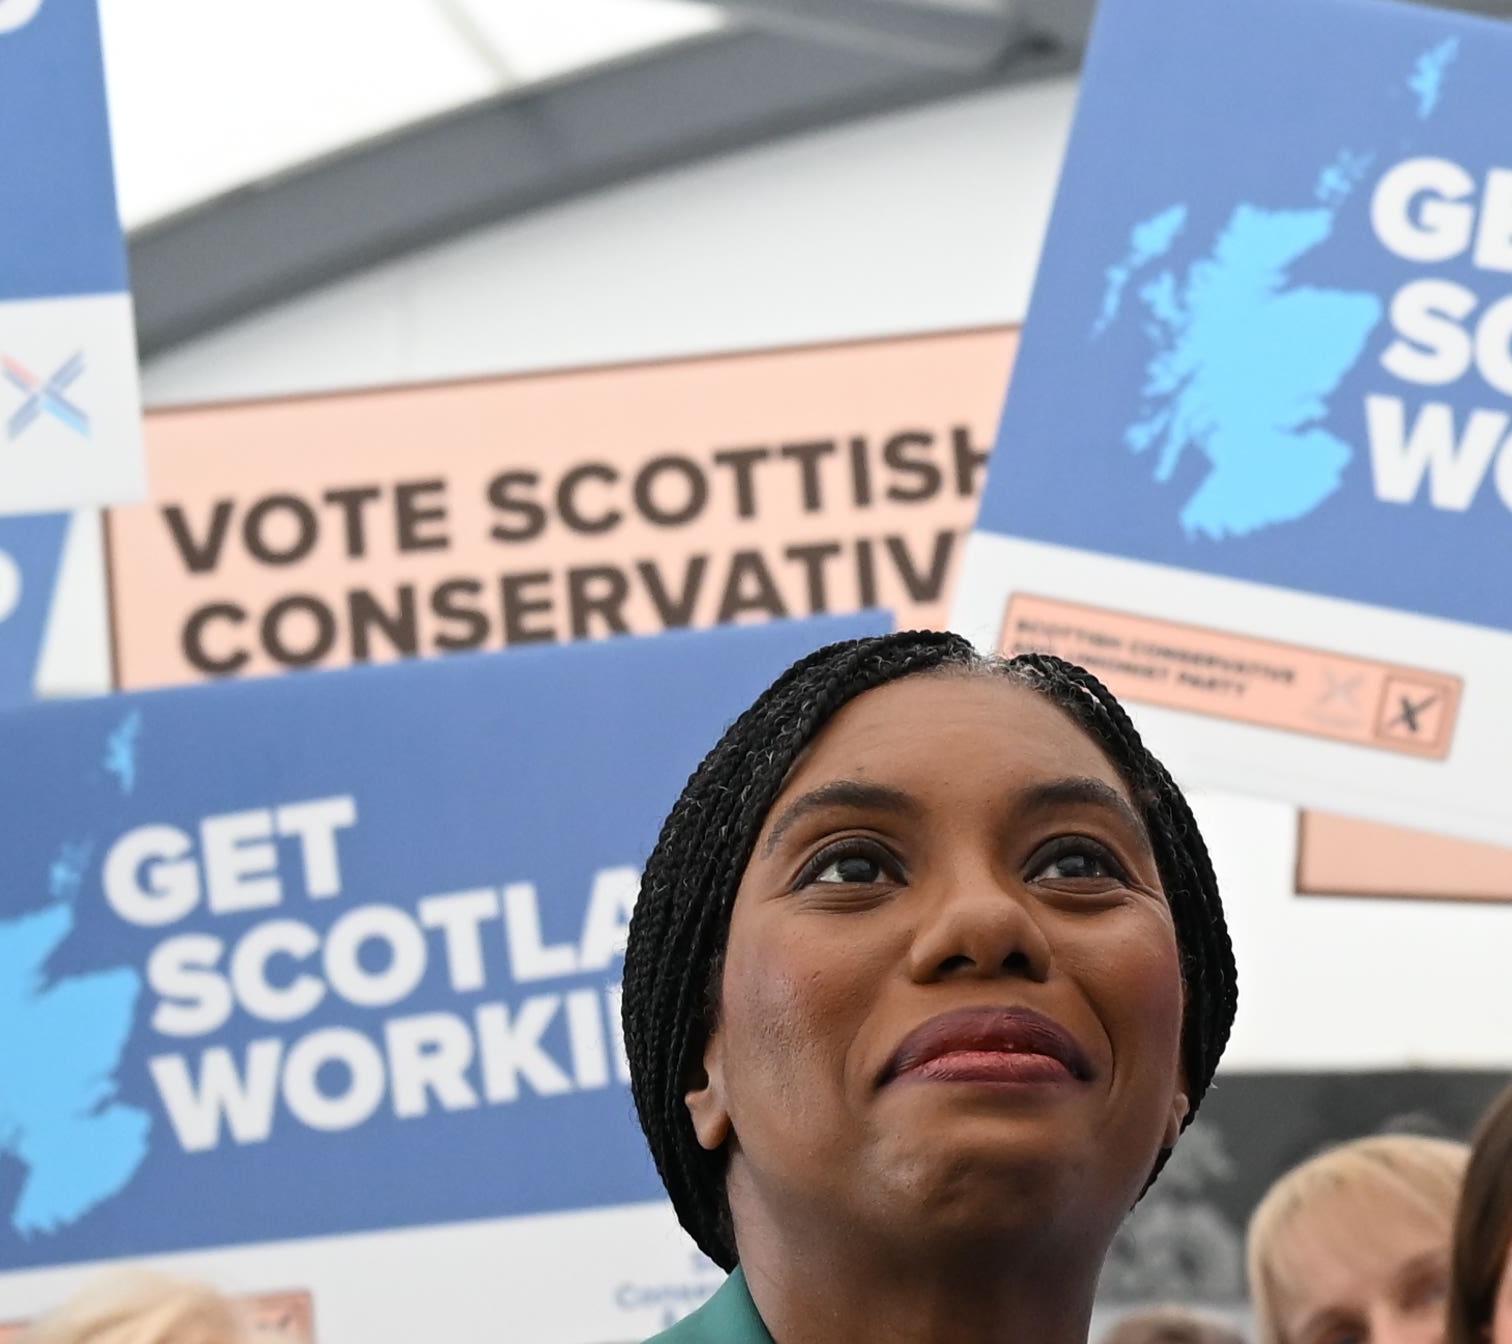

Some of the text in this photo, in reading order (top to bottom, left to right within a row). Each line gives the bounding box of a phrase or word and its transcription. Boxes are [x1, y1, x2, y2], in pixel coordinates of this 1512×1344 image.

[162, 424, 990, 576] VOTE SCOTTISH
[180, 529, 956, 676] CONSERVATIV
[102, 794, 358, 927] GET
[146, 864, 644, 1038] SCOTLA
[148, 986, 632, 1154] WORKI
